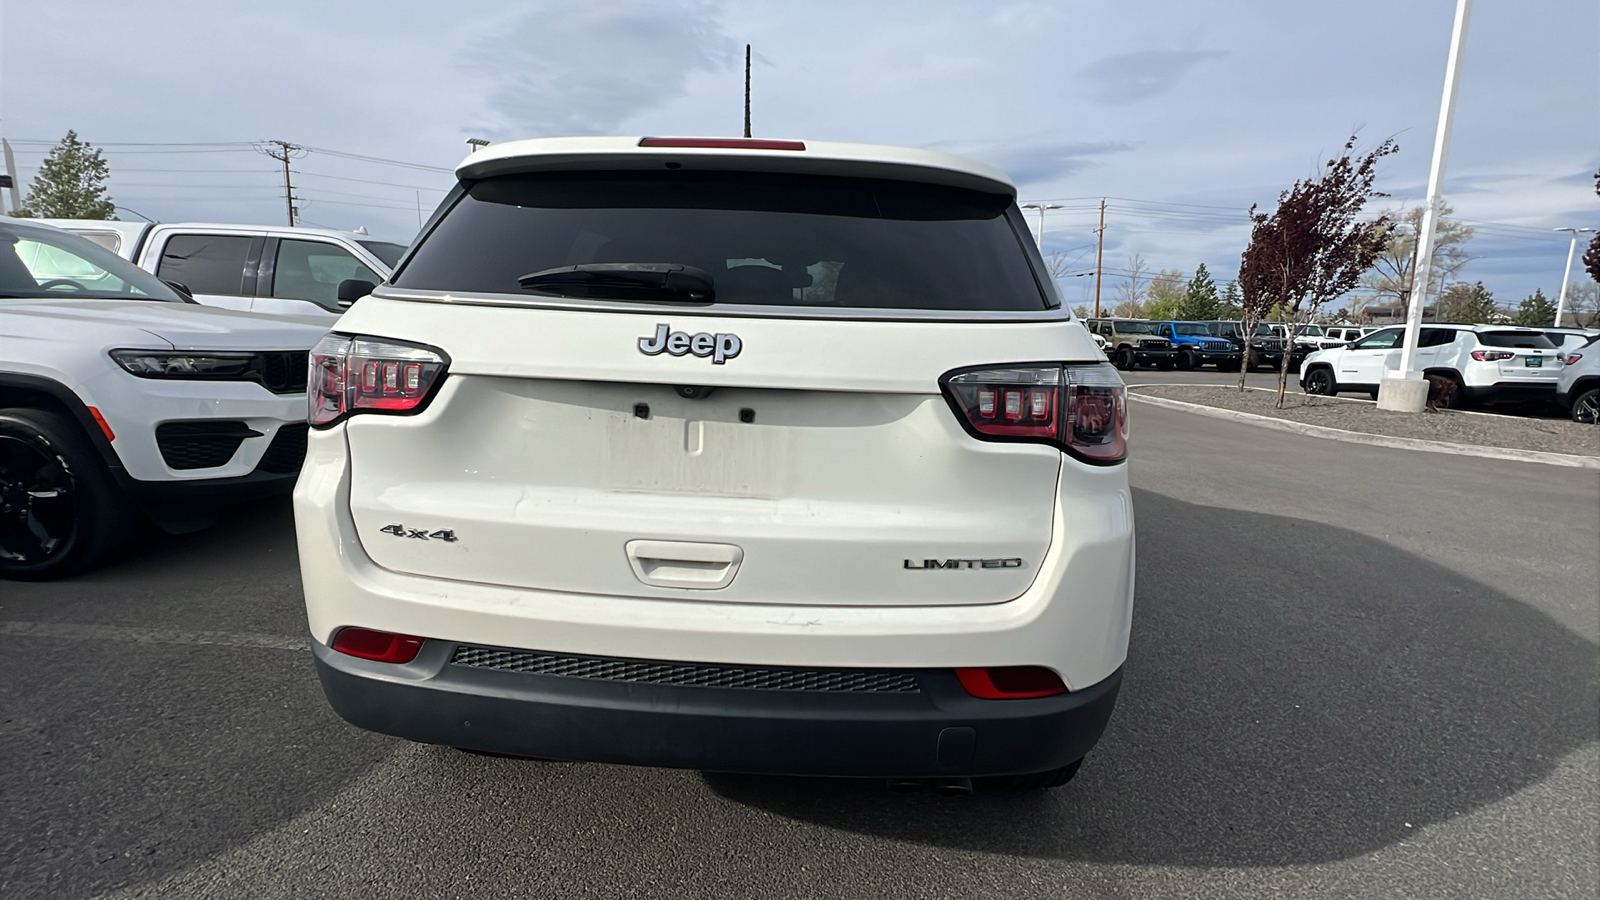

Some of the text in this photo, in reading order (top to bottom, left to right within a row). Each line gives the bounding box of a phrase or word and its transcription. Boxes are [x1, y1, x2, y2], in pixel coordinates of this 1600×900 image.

[638, 323, 742, 365] Jeep
[380, 523, 459, 542] 4x4
[903, 558, 1022, 569] LIMITED
